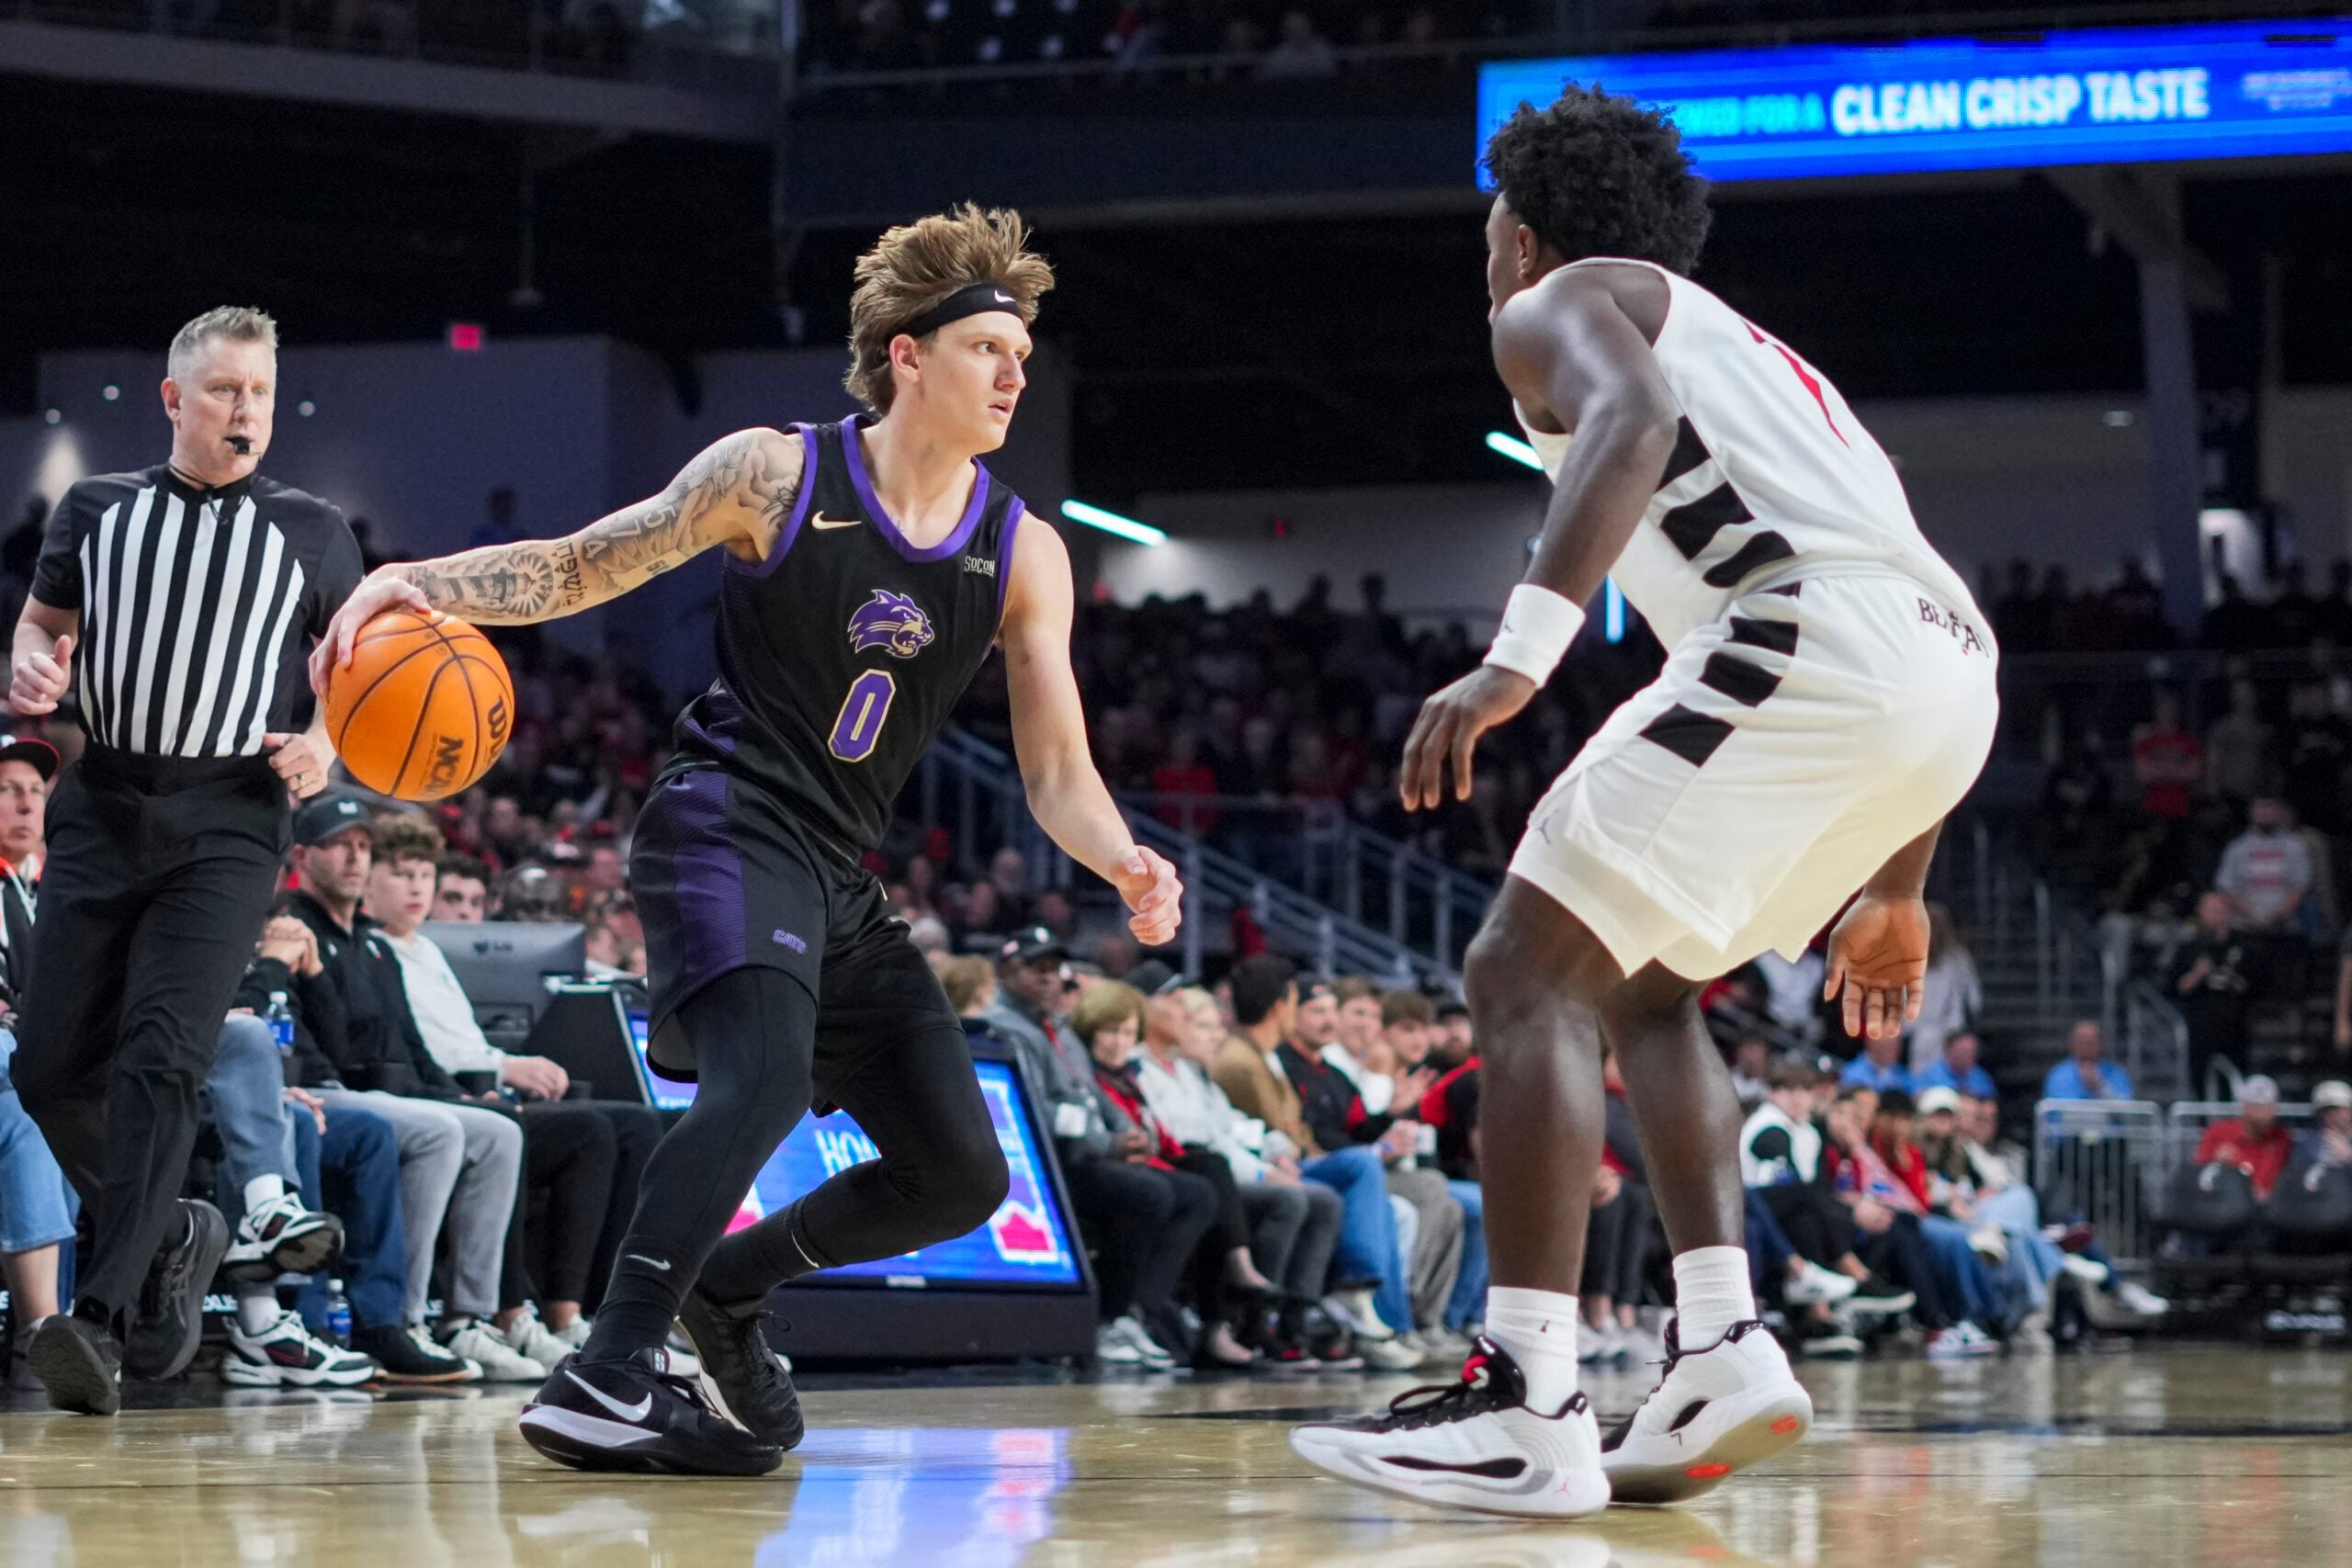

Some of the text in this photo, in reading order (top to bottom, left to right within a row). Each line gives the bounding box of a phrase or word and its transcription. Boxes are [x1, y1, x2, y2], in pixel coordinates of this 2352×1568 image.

[1803, 92, 1826, 132] A
[1833, 83, 1961, 135] CLEAN
[1966, 74, 2081, 129] CRISP
[2085, 67, 2210, 123] TASTE
[828, 669, 897, 763] 0
[425, 735, 464, 792] NCA
